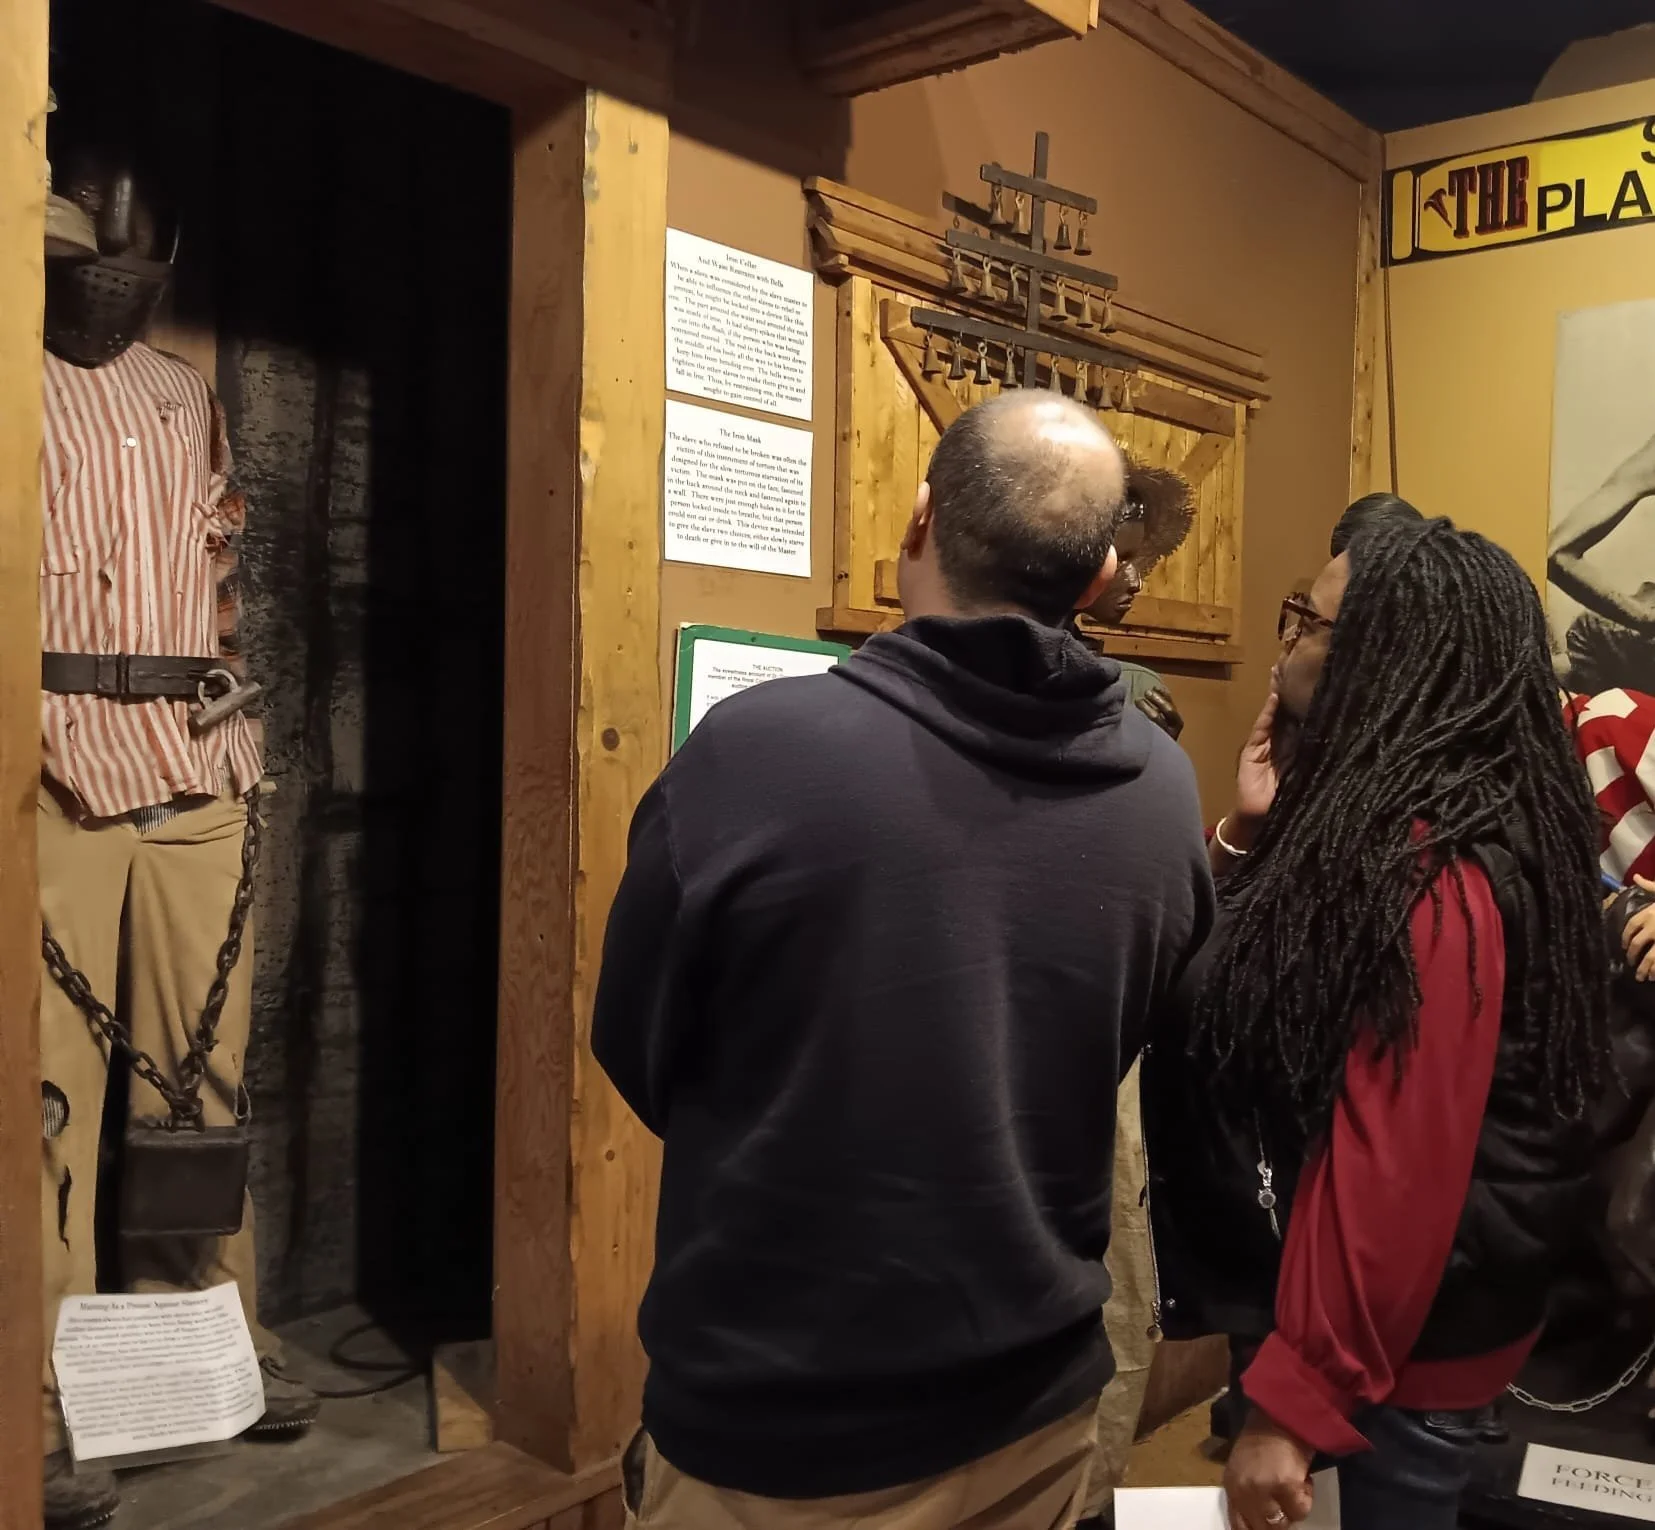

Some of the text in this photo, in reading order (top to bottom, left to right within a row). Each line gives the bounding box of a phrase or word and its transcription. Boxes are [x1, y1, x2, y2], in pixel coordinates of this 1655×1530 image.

[1449, 156, 1529, 239] THE
[670, 260, 688, 272] When
[769, 292, 782, 300] slave
[783, 296, 800, 305] master
[682, 435, 696, 443] slave
[712, 442, 733, 451] refused
[750, 448, 770, 458] broken
[782, 456, 796, 464] often
[732, 431, 745, 440] Iron
[746, 434, 761, 444] Mask
[671, 455, 698, 465] designed
[761, 474, 788, 484] starvation
[676, 446, 695, 454] victim
[704, 450, 715, 458] this
[716, 454, 748, 464] instrument
[755, 461, 776, 470] torture
[776, 464, 787, 472] that
[686, 479, 700, 488] back
[760, 492, 783, 503] fastened
[691, 490, 708, 500] There
[724, 497, 736, 505] just
[737, 501, 758, 509] enough
[780, 485, 803, 496] fastened
[692, 502, 711, 511] locked
[668, 510, 685, 518] could
[736, 519, 749, 528] This
[750, 522, 768, 531] device
[781, 526, 804, 536] intended
[701, 525, 715, 533] slave
[770, 535, 787, 543] slowly
[684, 533, 701, 541] death
[778, 546, 796, 554] Master
[1552, 1477, 1652, 1503] FEEDING
[1556, 1464, 1654, 1490] FORCE
